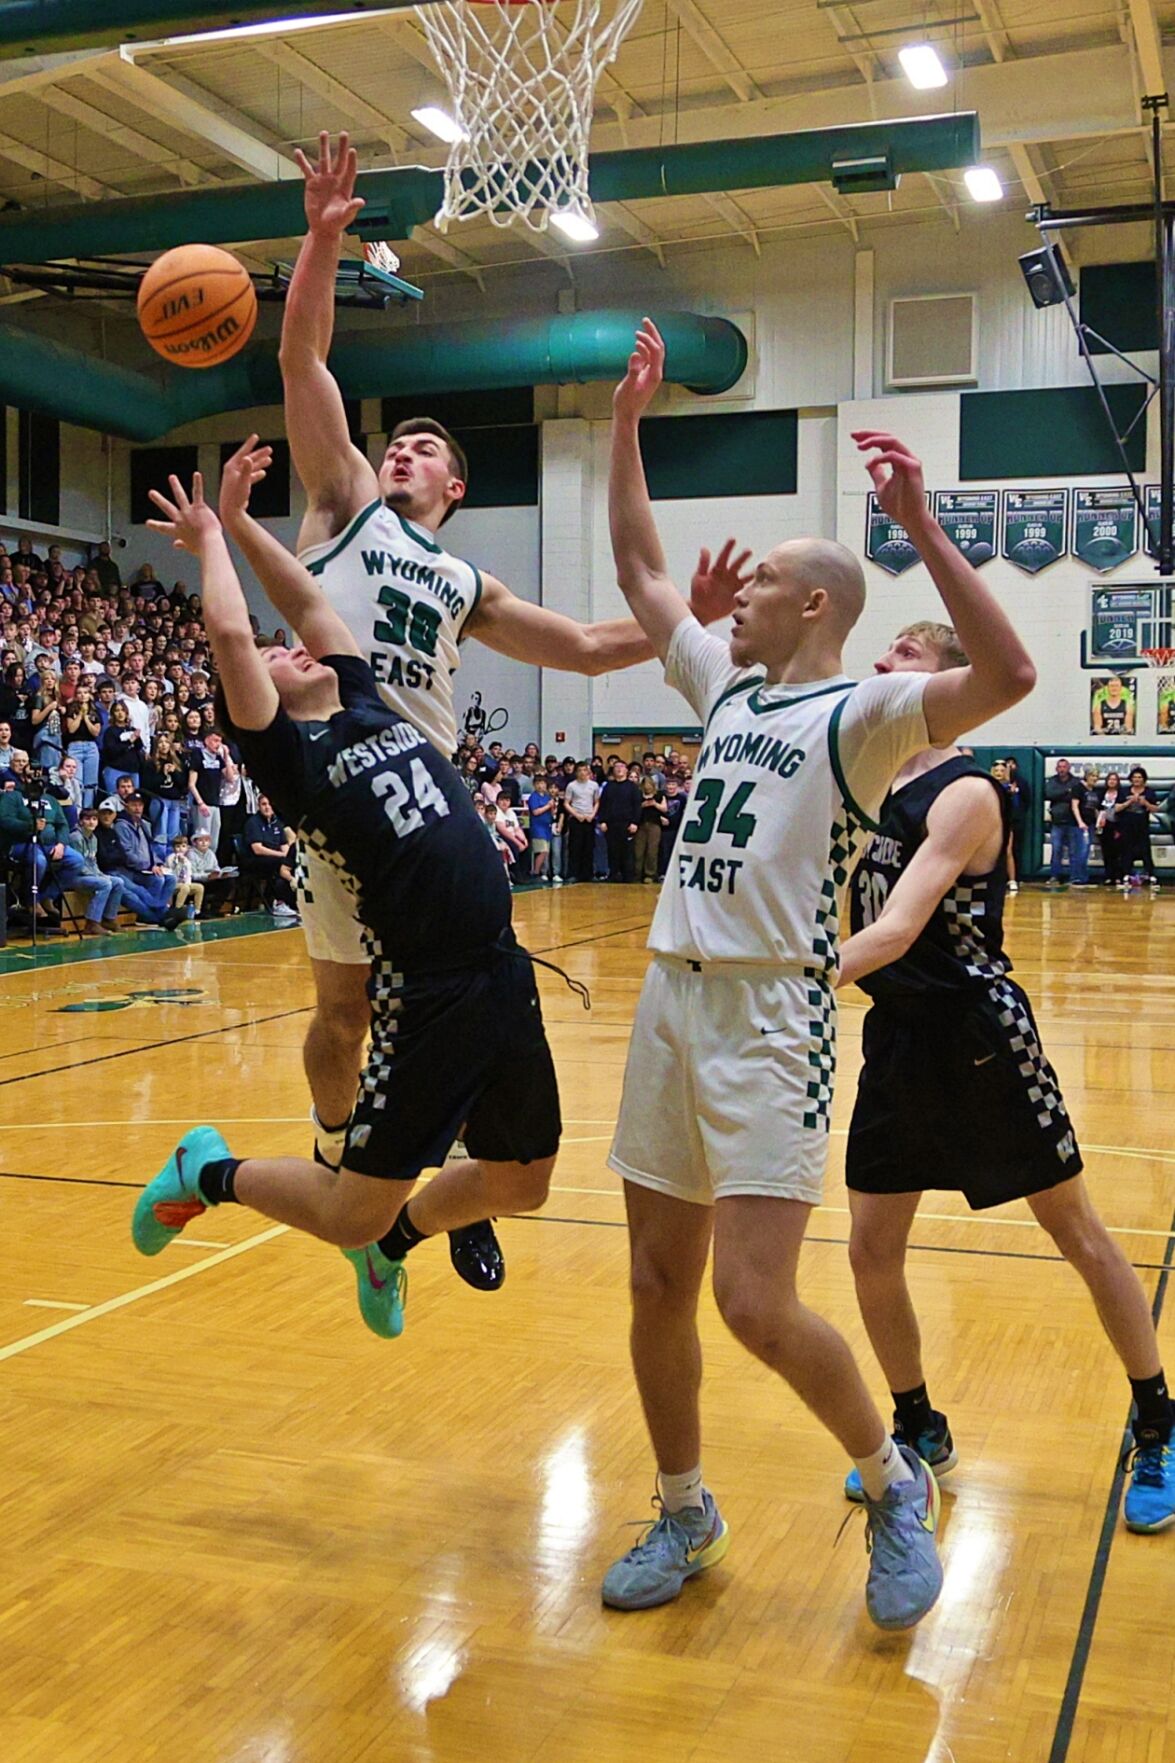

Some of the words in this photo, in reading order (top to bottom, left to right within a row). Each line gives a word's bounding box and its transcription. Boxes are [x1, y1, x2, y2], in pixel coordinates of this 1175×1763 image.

[165, 316, 241, 354] Wilson
[955, 528, 977, 539] 1999
[1024, 527, 1047, 538] 1999
[1093, 525, 1118, 537] 2000
[361, 550, 466, 621] WYOMING
[1109, 628, 1134, 640] 2019
[370, 652, 436, 690] EAST
[326, 721, 428, 789] WESTSIDE
[698, 732, 806, 779] WYOMING
[371, 757, 450, 838] 24
[682, 778, 757, 848] 34
[679, 854, 743, 894] EAST
